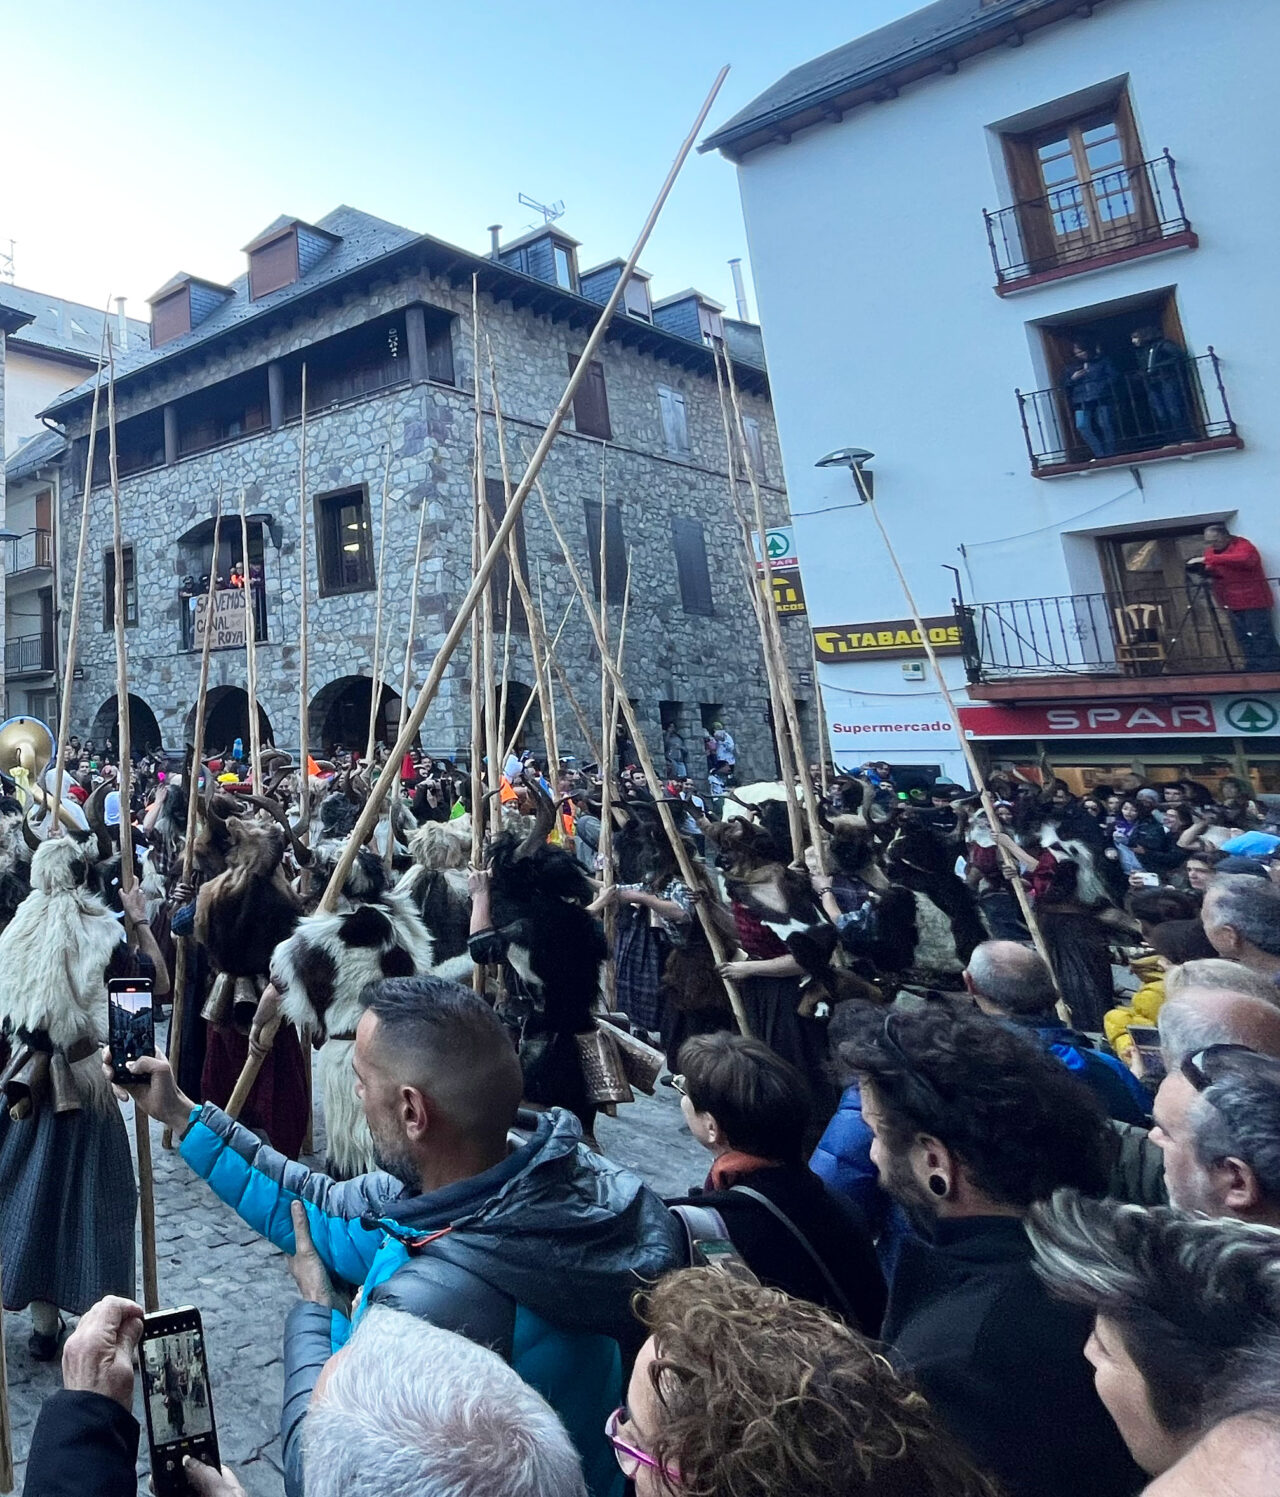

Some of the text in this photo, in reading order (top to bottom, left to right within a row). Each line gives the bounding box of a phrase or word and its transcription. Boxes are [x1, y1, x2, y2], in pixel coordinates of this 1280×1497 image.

[760, 558, 793, 567] PAR
[196, 589, 246, 613] SAVEMOS
[776, 603, 805, 612] ACOS
[218, 630, 244, 645] ROYA
[846, 626, 962, 647] TABACOS
[1046, 704, 1211, 730] SPAR
[832, 721, 952, 735] Supermercado
